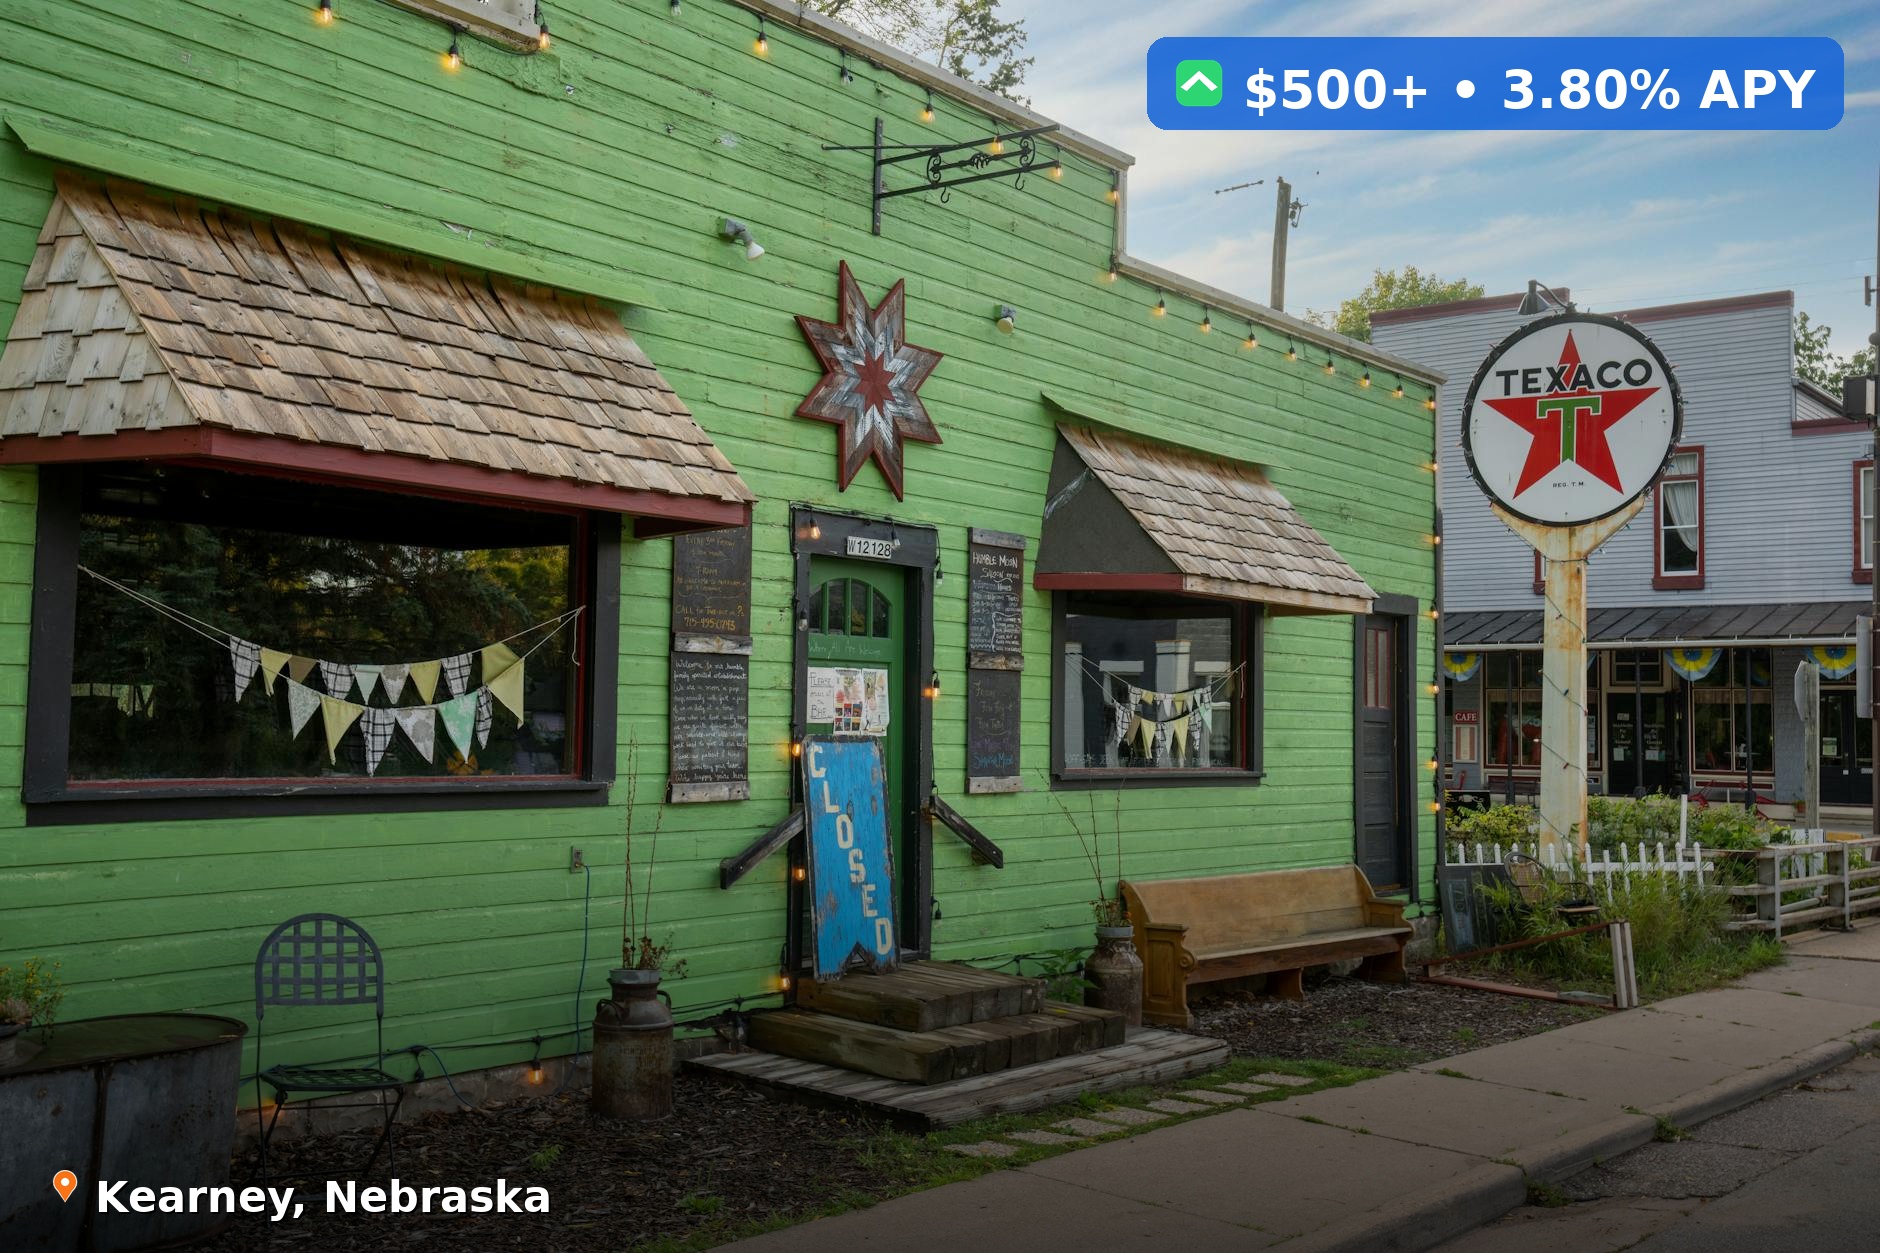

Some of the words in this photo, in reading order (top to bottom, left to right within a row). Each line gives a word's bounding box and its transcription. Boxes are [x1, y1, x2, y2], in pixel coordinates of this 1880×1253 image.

[1496, 359, 1652, 397] TEXACO
[848, 539, 891, 557] W12128
[809, 745, 893, 955] CLOSED
